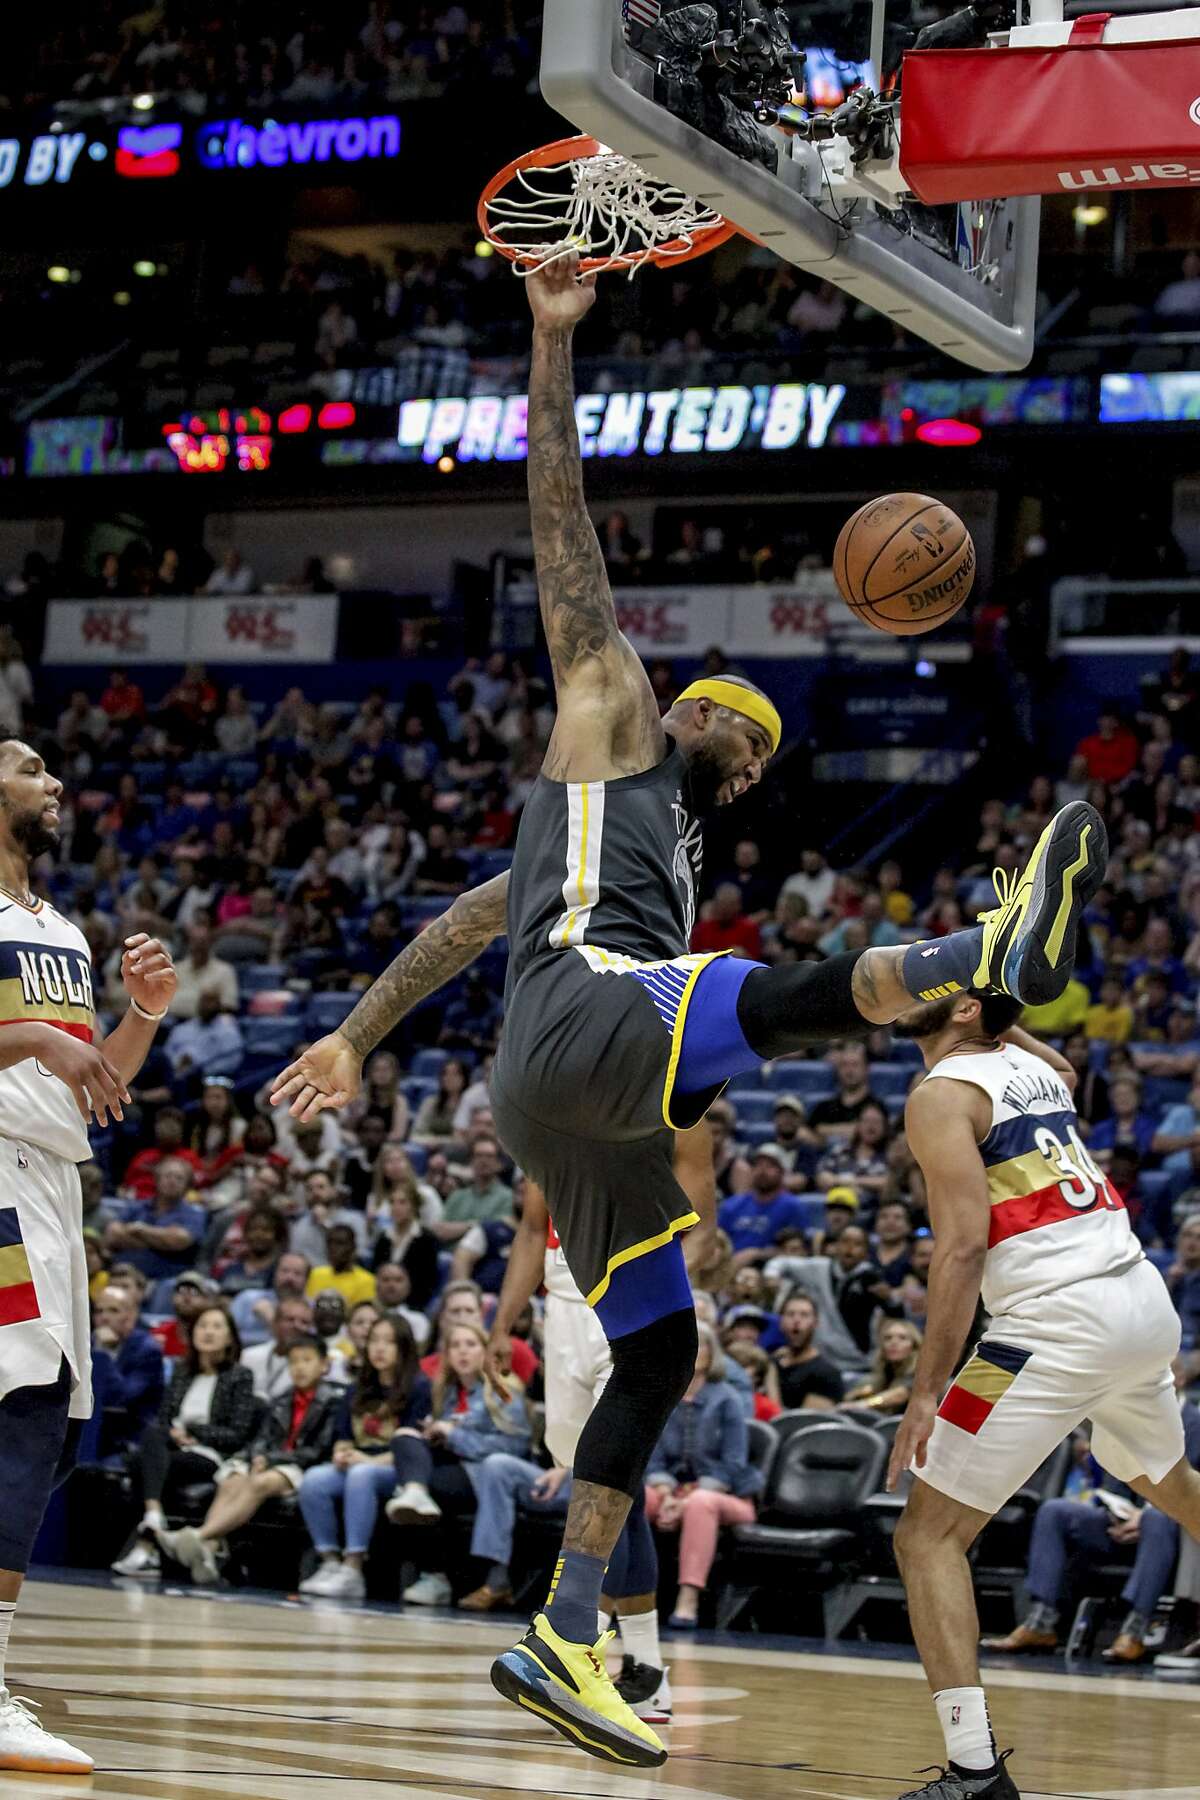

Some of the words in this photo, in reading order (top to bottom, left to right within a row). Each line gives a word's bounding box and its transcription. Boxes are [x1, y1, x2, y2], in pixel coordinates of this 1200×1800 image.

[24, 133, 86, 185] BY
[200, 115, 400, 169] Chevron
[423, 385, 752, 463] PREENTED
[761, 383, 845, 450] BY
[1034, 1124, 1118, 1212] 34
